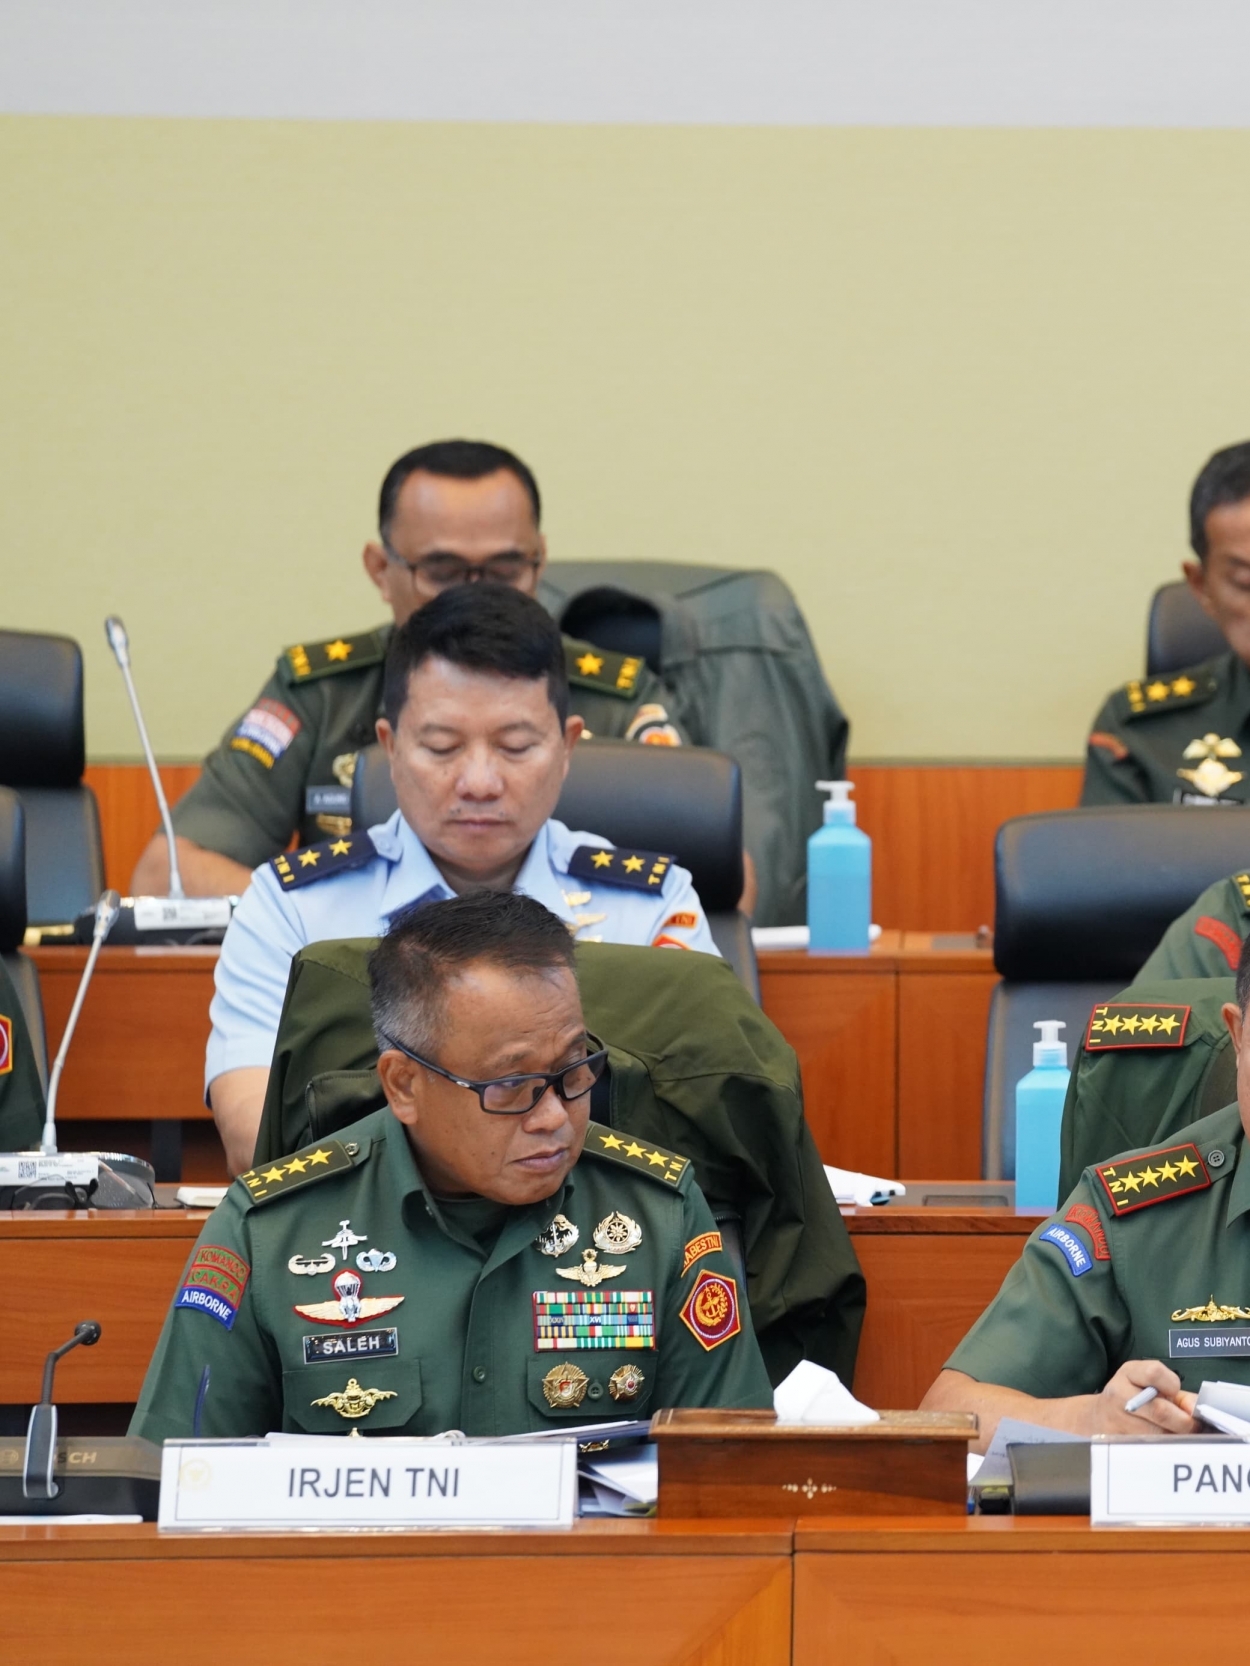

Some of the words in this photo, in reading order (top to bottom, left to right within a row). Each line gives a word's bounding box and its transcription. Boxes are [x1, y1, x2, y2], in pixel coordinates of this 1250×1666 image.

[648, 856, 670, 885] TNI
[1089, 1007, 1108, 1043] TNI
[664, 1155, 687, 1181] TNI
[243, 1170, 267, 1197] TNI
[1103, 1167, 1129, 1206] TNI
[1047, 1227, 1086, 1268] AIRBORNE
[200, 1249, 247, 1279] KOMANDO
[191, 1270, 237, 1301] CAKRA
[181, 1290, 232, 1321] AIRBORNE
[323, 1336, 380, 1354] SALEH
[1176, 1337, 1200, 1348] AGUS
[289, 1468, 391, 1498] IRJEN
[405, 1467, 459, 1496] TNI
